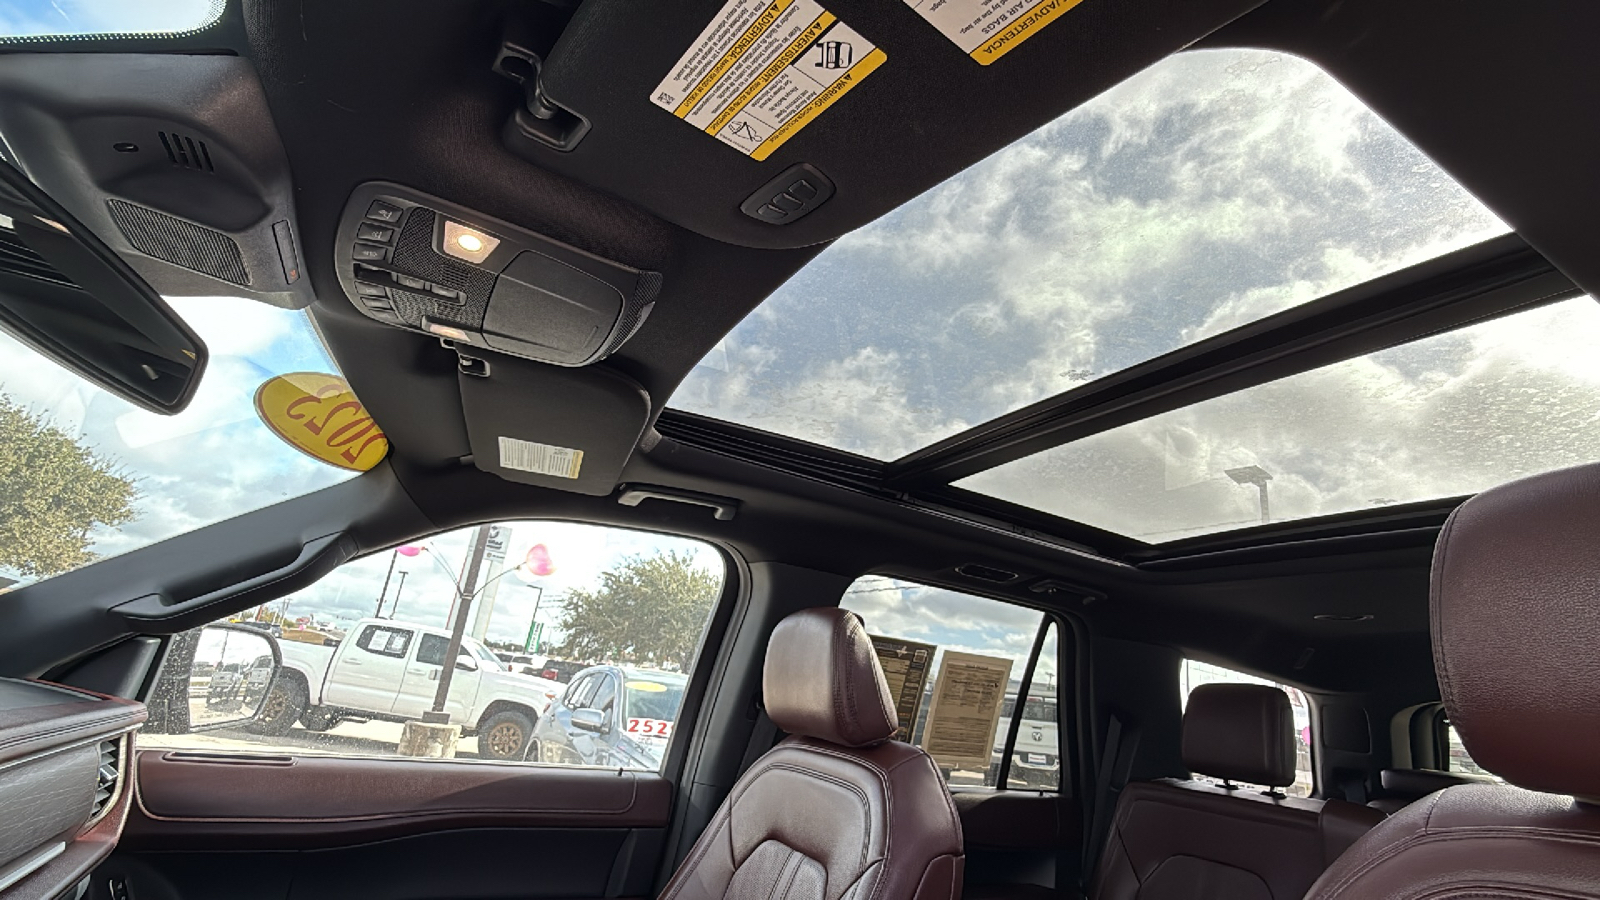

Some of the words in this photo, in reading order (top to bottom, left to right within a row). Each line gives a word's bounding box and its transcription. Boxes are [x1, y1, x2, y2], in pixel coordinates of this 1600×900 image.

[981, 13, 1009, 34] BAGS
[1007, 2, 1024, 15] AIR
[726, 10, 775, 62] ADVERTENCIA:
[983, 0, 1067, 54] /ADVERTENCIA
[758, 27, 817, 83] AVERTISSEMENT:
[810, 78, 848, 108] WARNING:
[628, 719, 673, 735] 252
